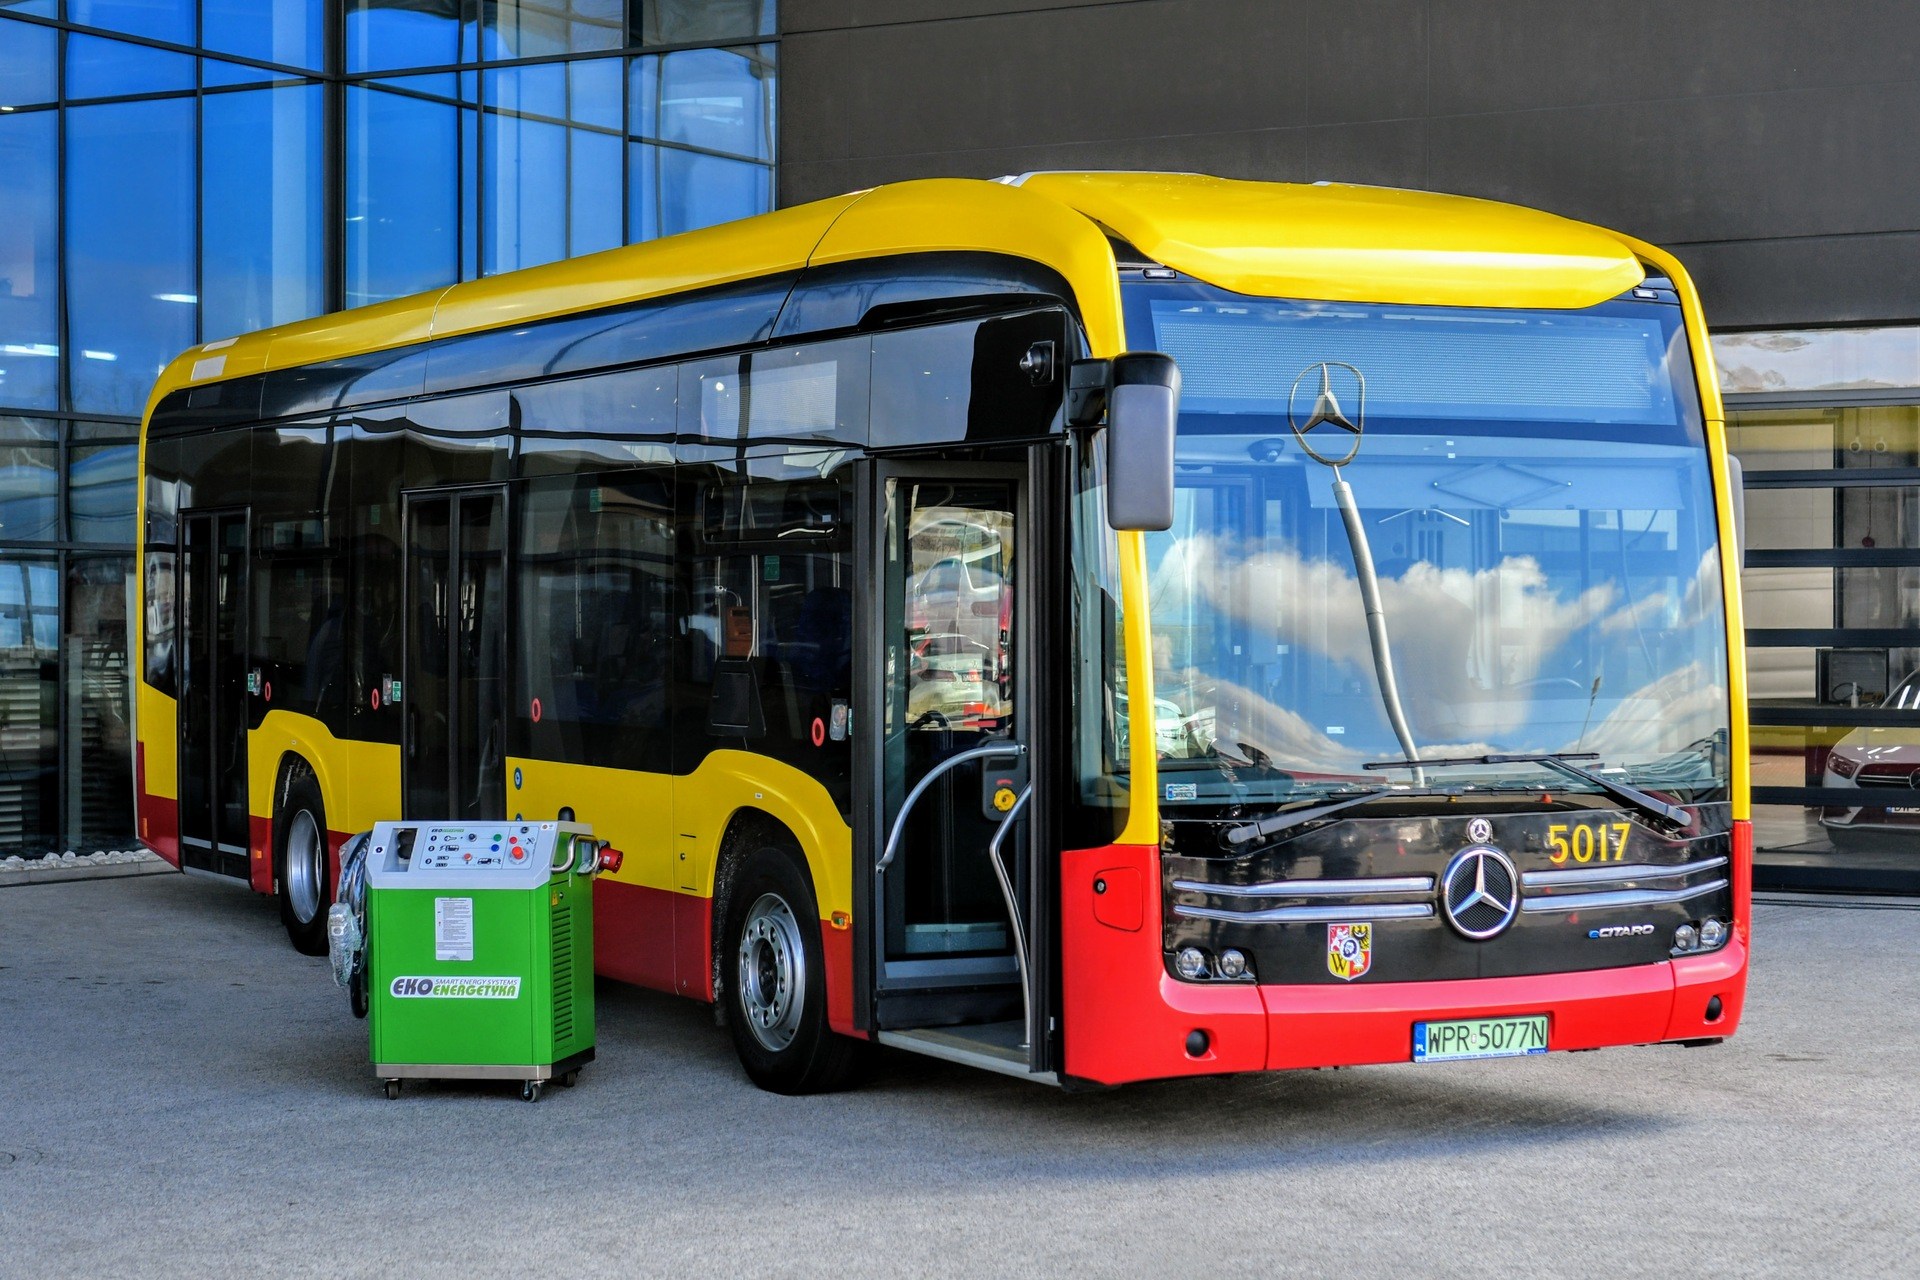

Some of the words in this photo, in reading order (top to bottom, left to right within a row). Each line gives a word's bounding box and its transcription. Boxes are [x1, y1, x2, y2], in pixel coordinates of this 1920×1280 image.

[1548, 823, 1631, 863] 5017
[1330, 953, 1348, 973] W
[392, 978, 434, 996] EKO
[432, 984, 517, 997] ENERGETYKA
[459, 978, 487, 986] ENERGY
[1428, 1025, 1470, 1054] WPR
[1478, 1020, 1546, 1050] 5077N
[1415, 1043, 1425, 1052] PL
